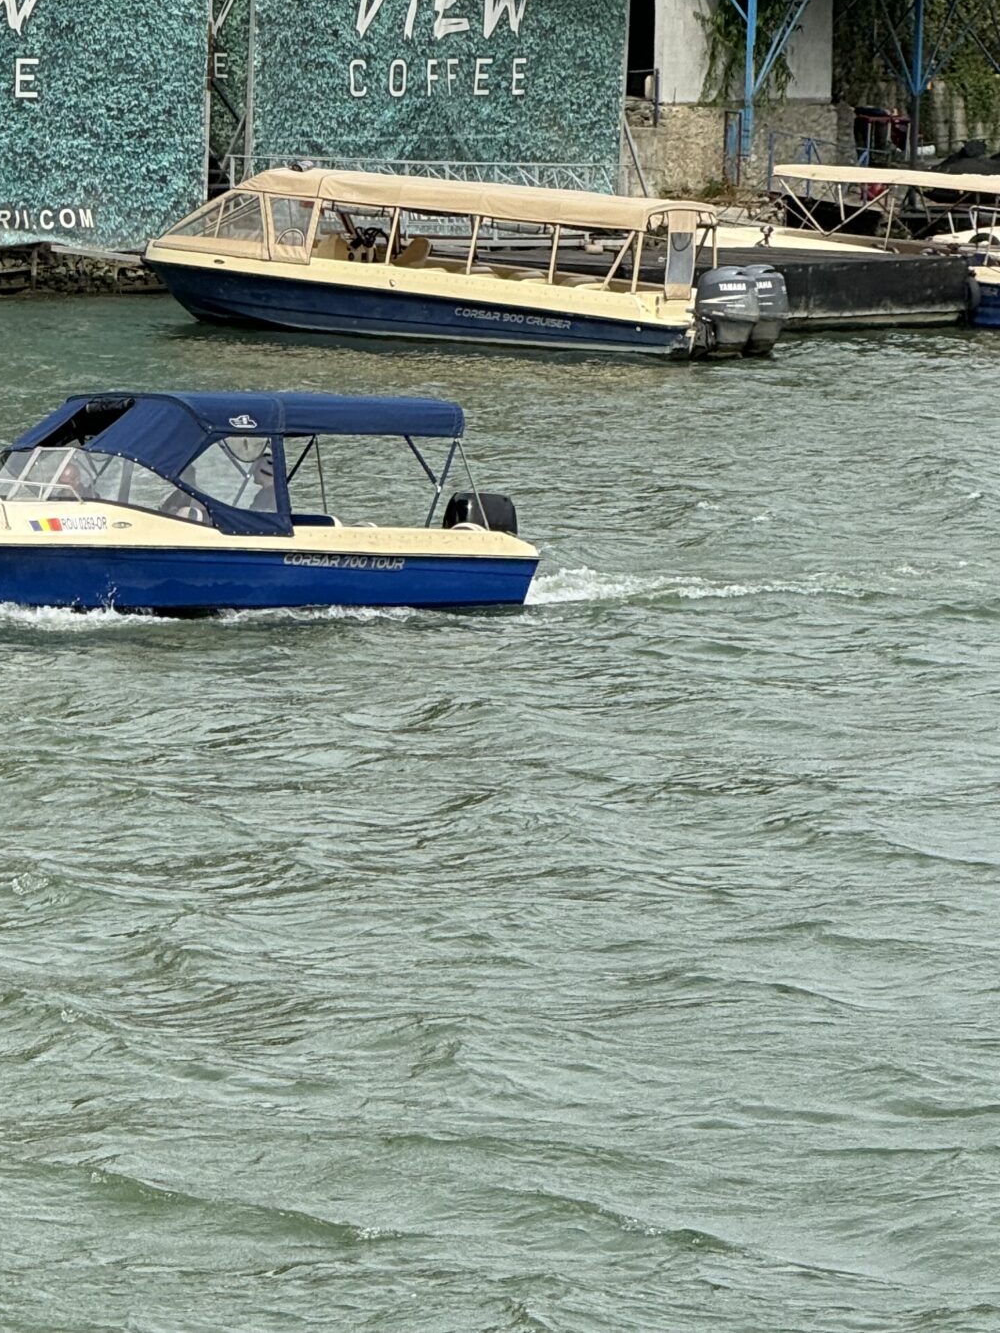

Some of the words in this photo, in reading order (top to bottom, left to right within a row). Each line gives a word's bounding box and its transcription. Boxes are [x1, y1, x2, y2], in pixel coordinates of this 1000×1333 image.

[349, 57, 528, 97] COFFEE
[719, 283, 747, 291] YAMAHA
[454, 307, 500, 321] CORSAR
[502, 313, 524, 323] 900
[526, 316, 572, 329] CRUISER
[283, 553, 340, 567] CORSAR
[342, 555, 367, 568] 700
[370, 557, 405, 570] TOUR
